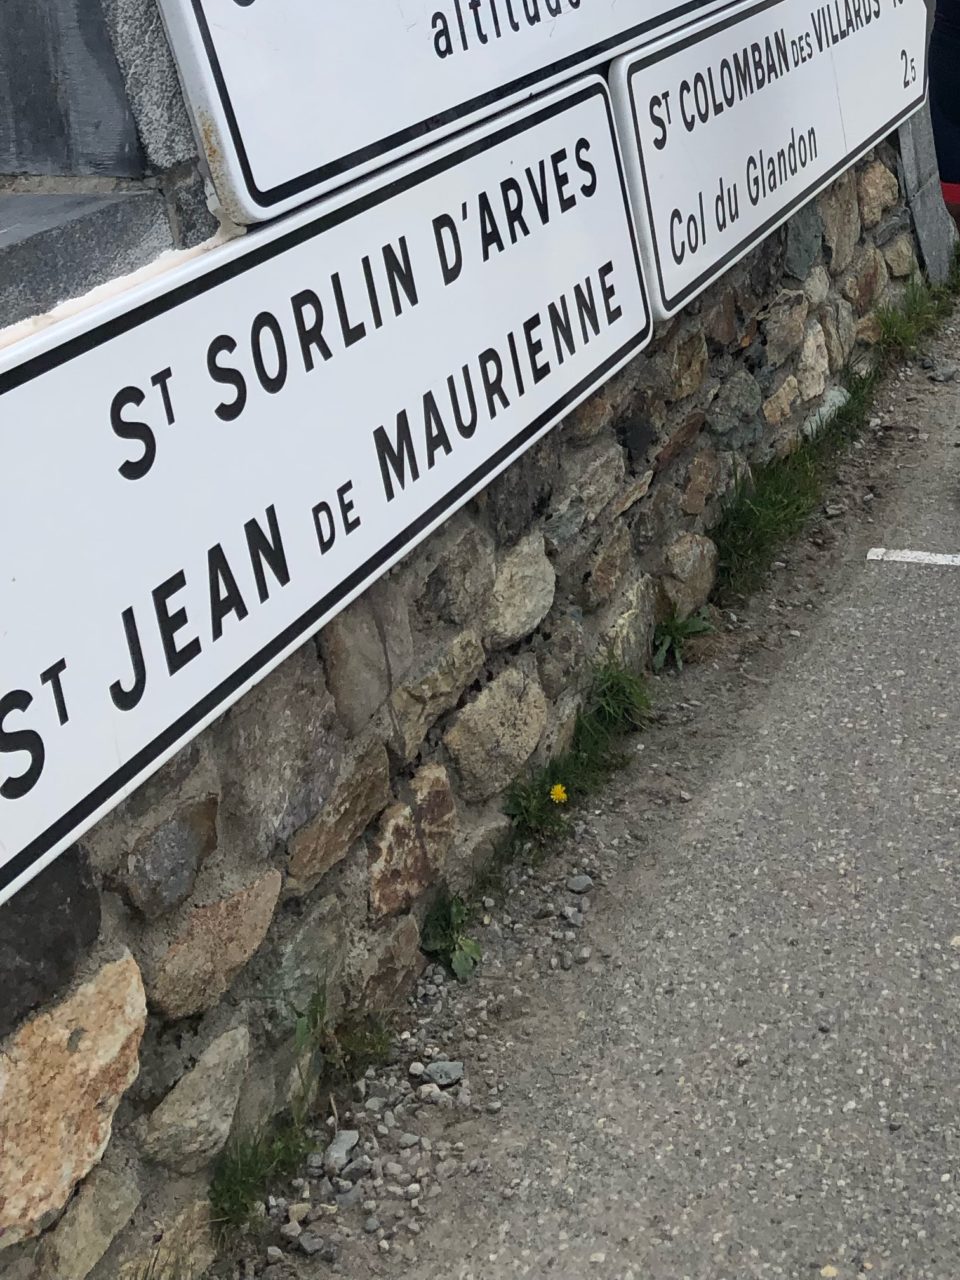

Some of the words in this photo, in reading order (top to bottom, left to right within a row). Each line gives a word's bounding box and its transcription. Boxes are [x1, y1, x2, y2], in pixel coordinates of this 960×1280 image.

[680, 28, 790, 132] COLOMBAN
[791, 32, 814, 68] DES
[207, 235, 419, 422] SORLIN
[432, 137, 598, 286] D'ARVES
[670, 191, 707, 266] Col
[715, 177, 740, 233] du
[746, 126, 819, 207] Glandon
[110, 504, 291, 712] JEAN
[312, 479, 361, 556] DE
[373, 261, 623, 503] MAURIENNE
